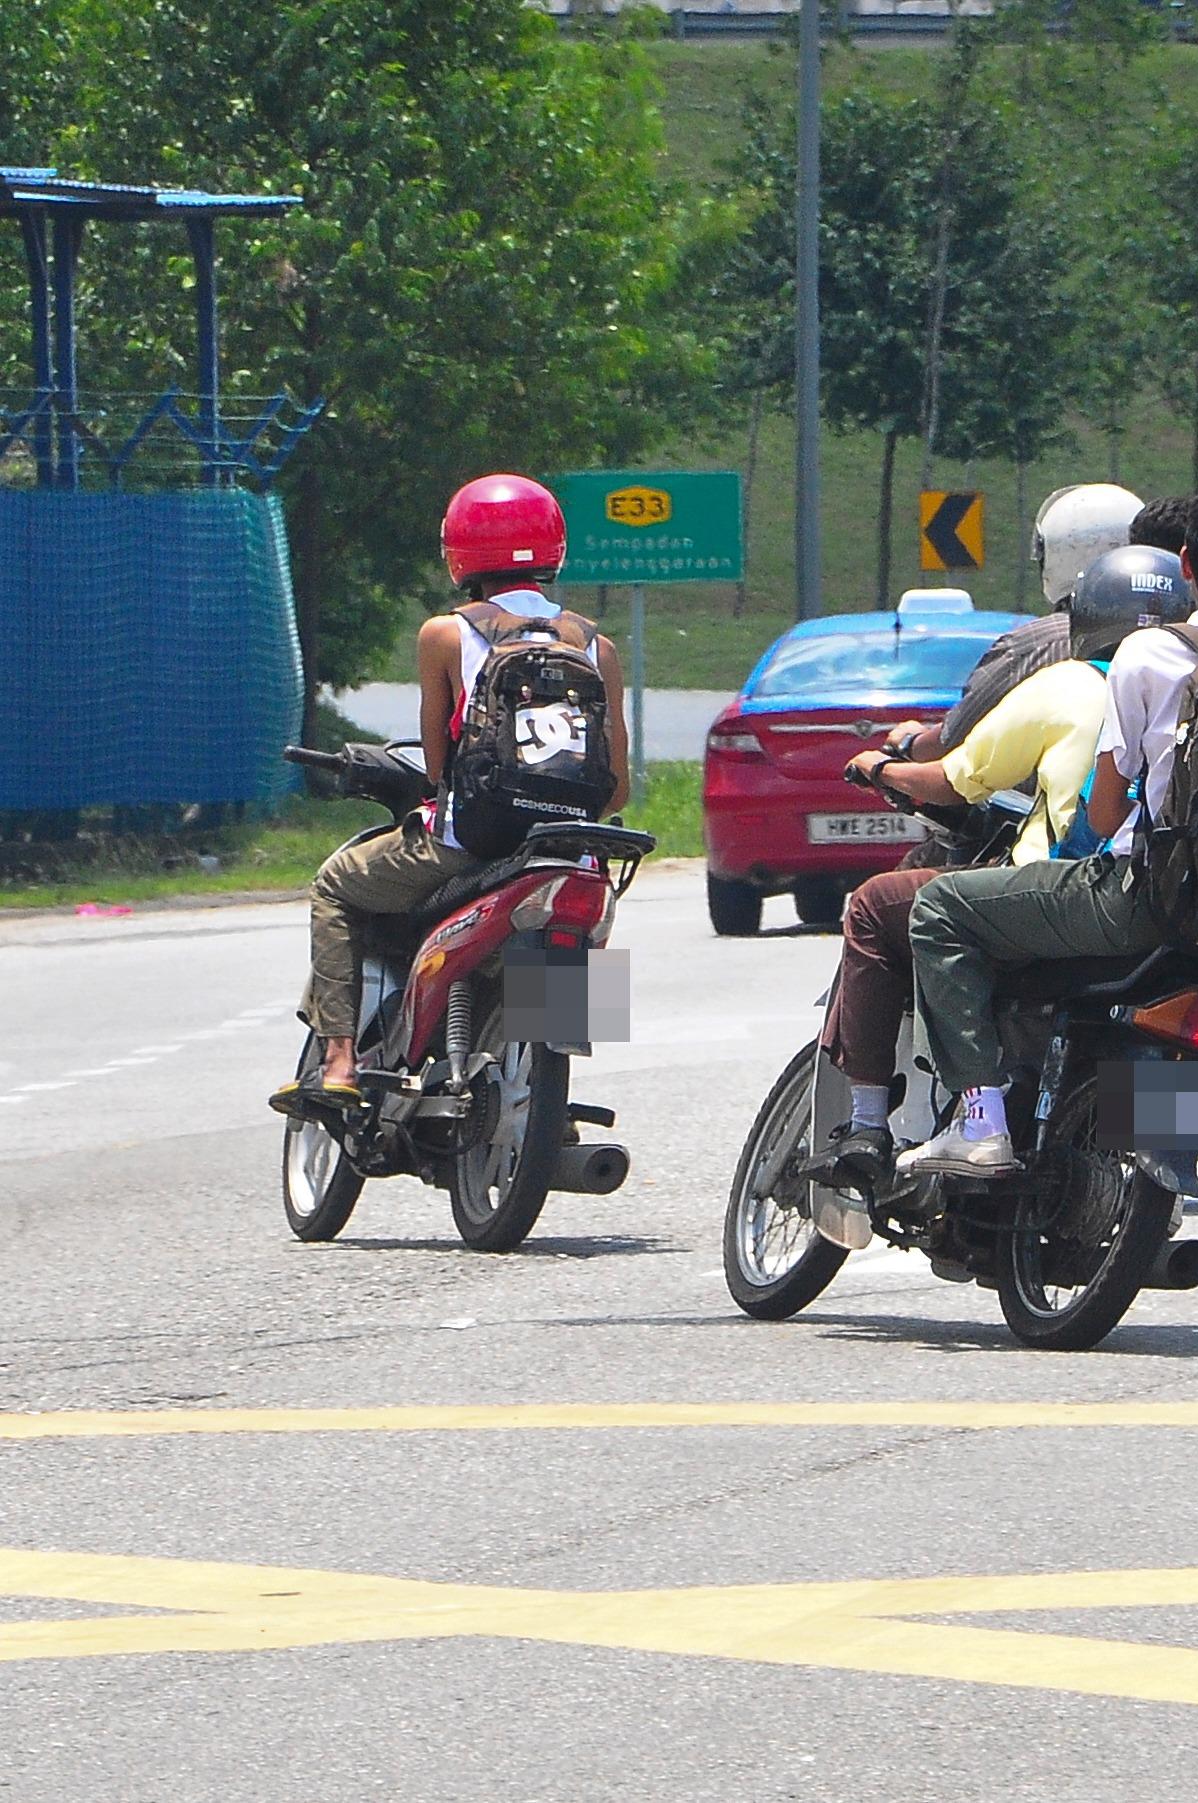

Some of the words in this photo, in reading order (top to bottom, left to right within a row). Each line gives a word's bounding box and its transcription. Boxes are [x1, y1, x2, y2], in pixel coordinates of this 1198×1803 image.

[610, 496, 665, 518] E33
[1131, 573, 1173, 592] INDEX
[828, 818, 860, 835] HWE
[866, 817, 906, 835] 2514
